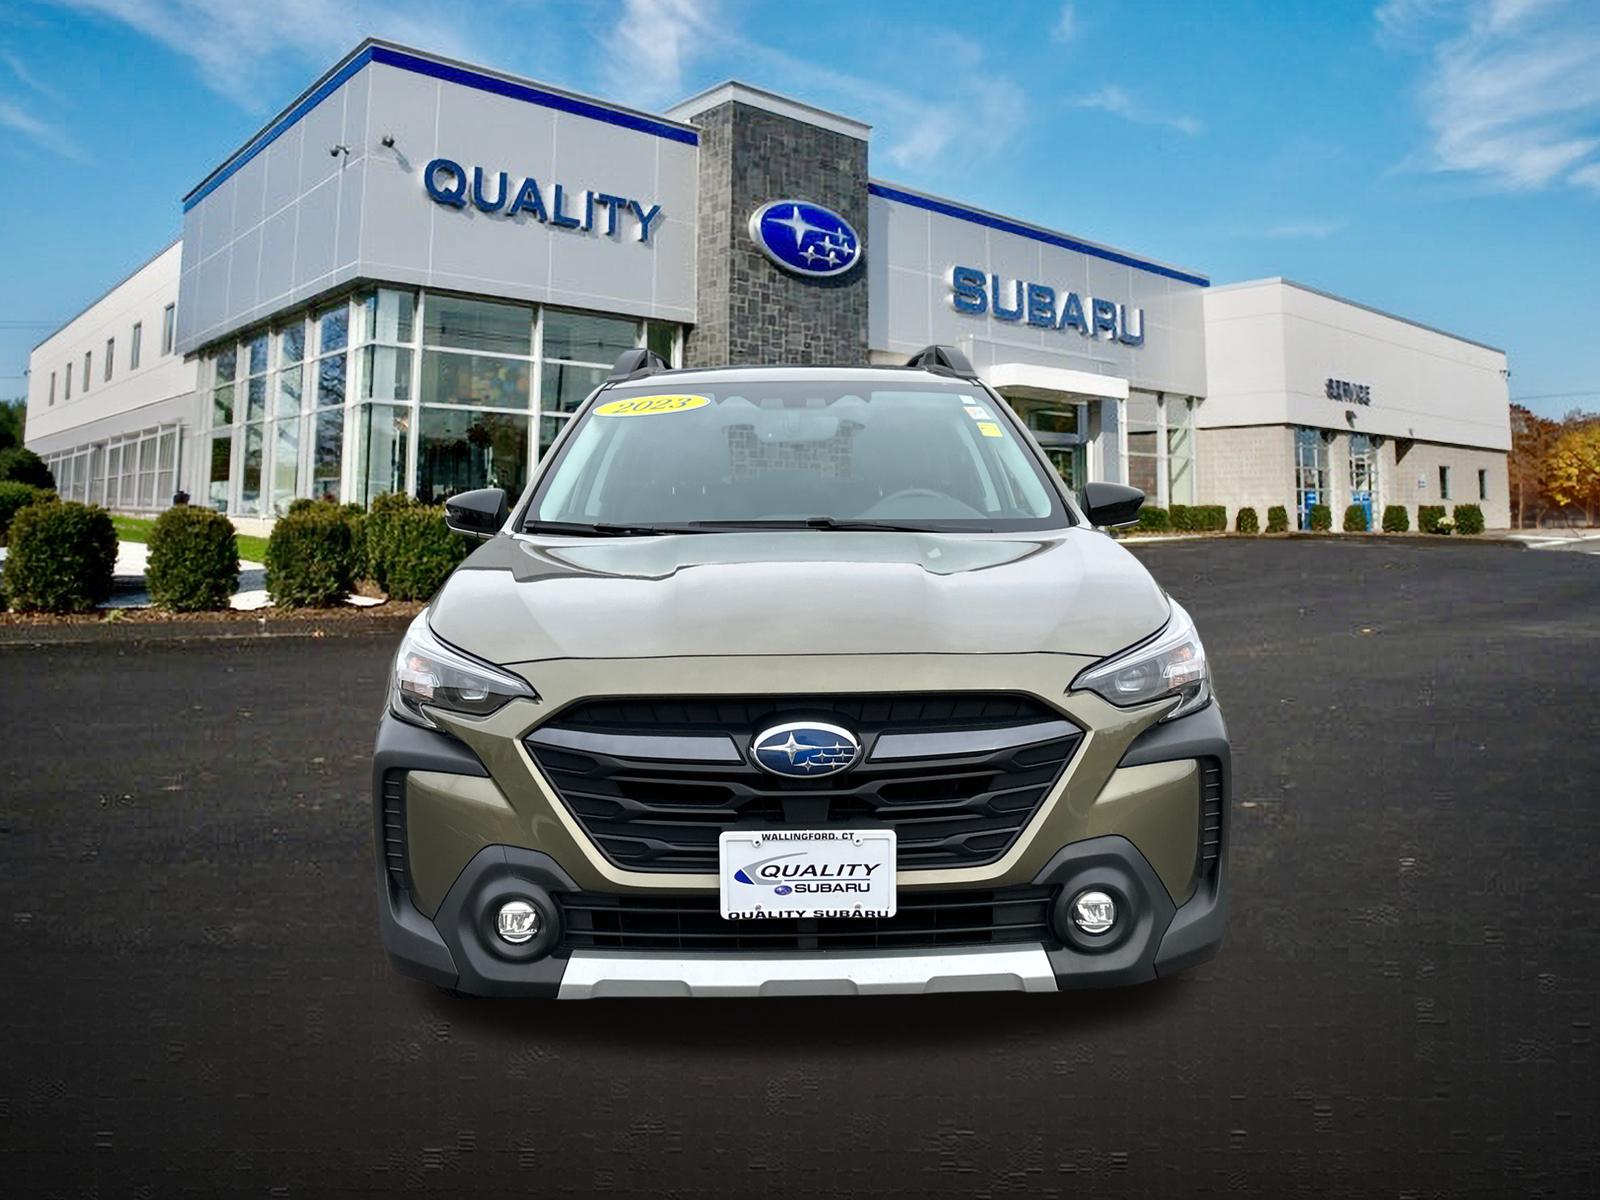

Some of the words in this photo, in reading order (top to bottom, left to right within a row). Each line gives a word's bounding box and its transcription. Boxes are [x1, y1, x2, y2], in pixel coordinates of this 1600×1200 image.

[424, 158, 661, 242] QUALITY
[950, 265, 1144, 346] SUBARU
[1325, 378, 1371, 406] SERVICE
[612, 398, 692, 414] 2023
[841, 832, 855, 841] CT
[760, 863, 881, 879] QUALITY
[794, 883, 871, 893] SUBARU
[728, 910, 806, 919] QUALITY
[812, 909, 889, 919] SUBARU
